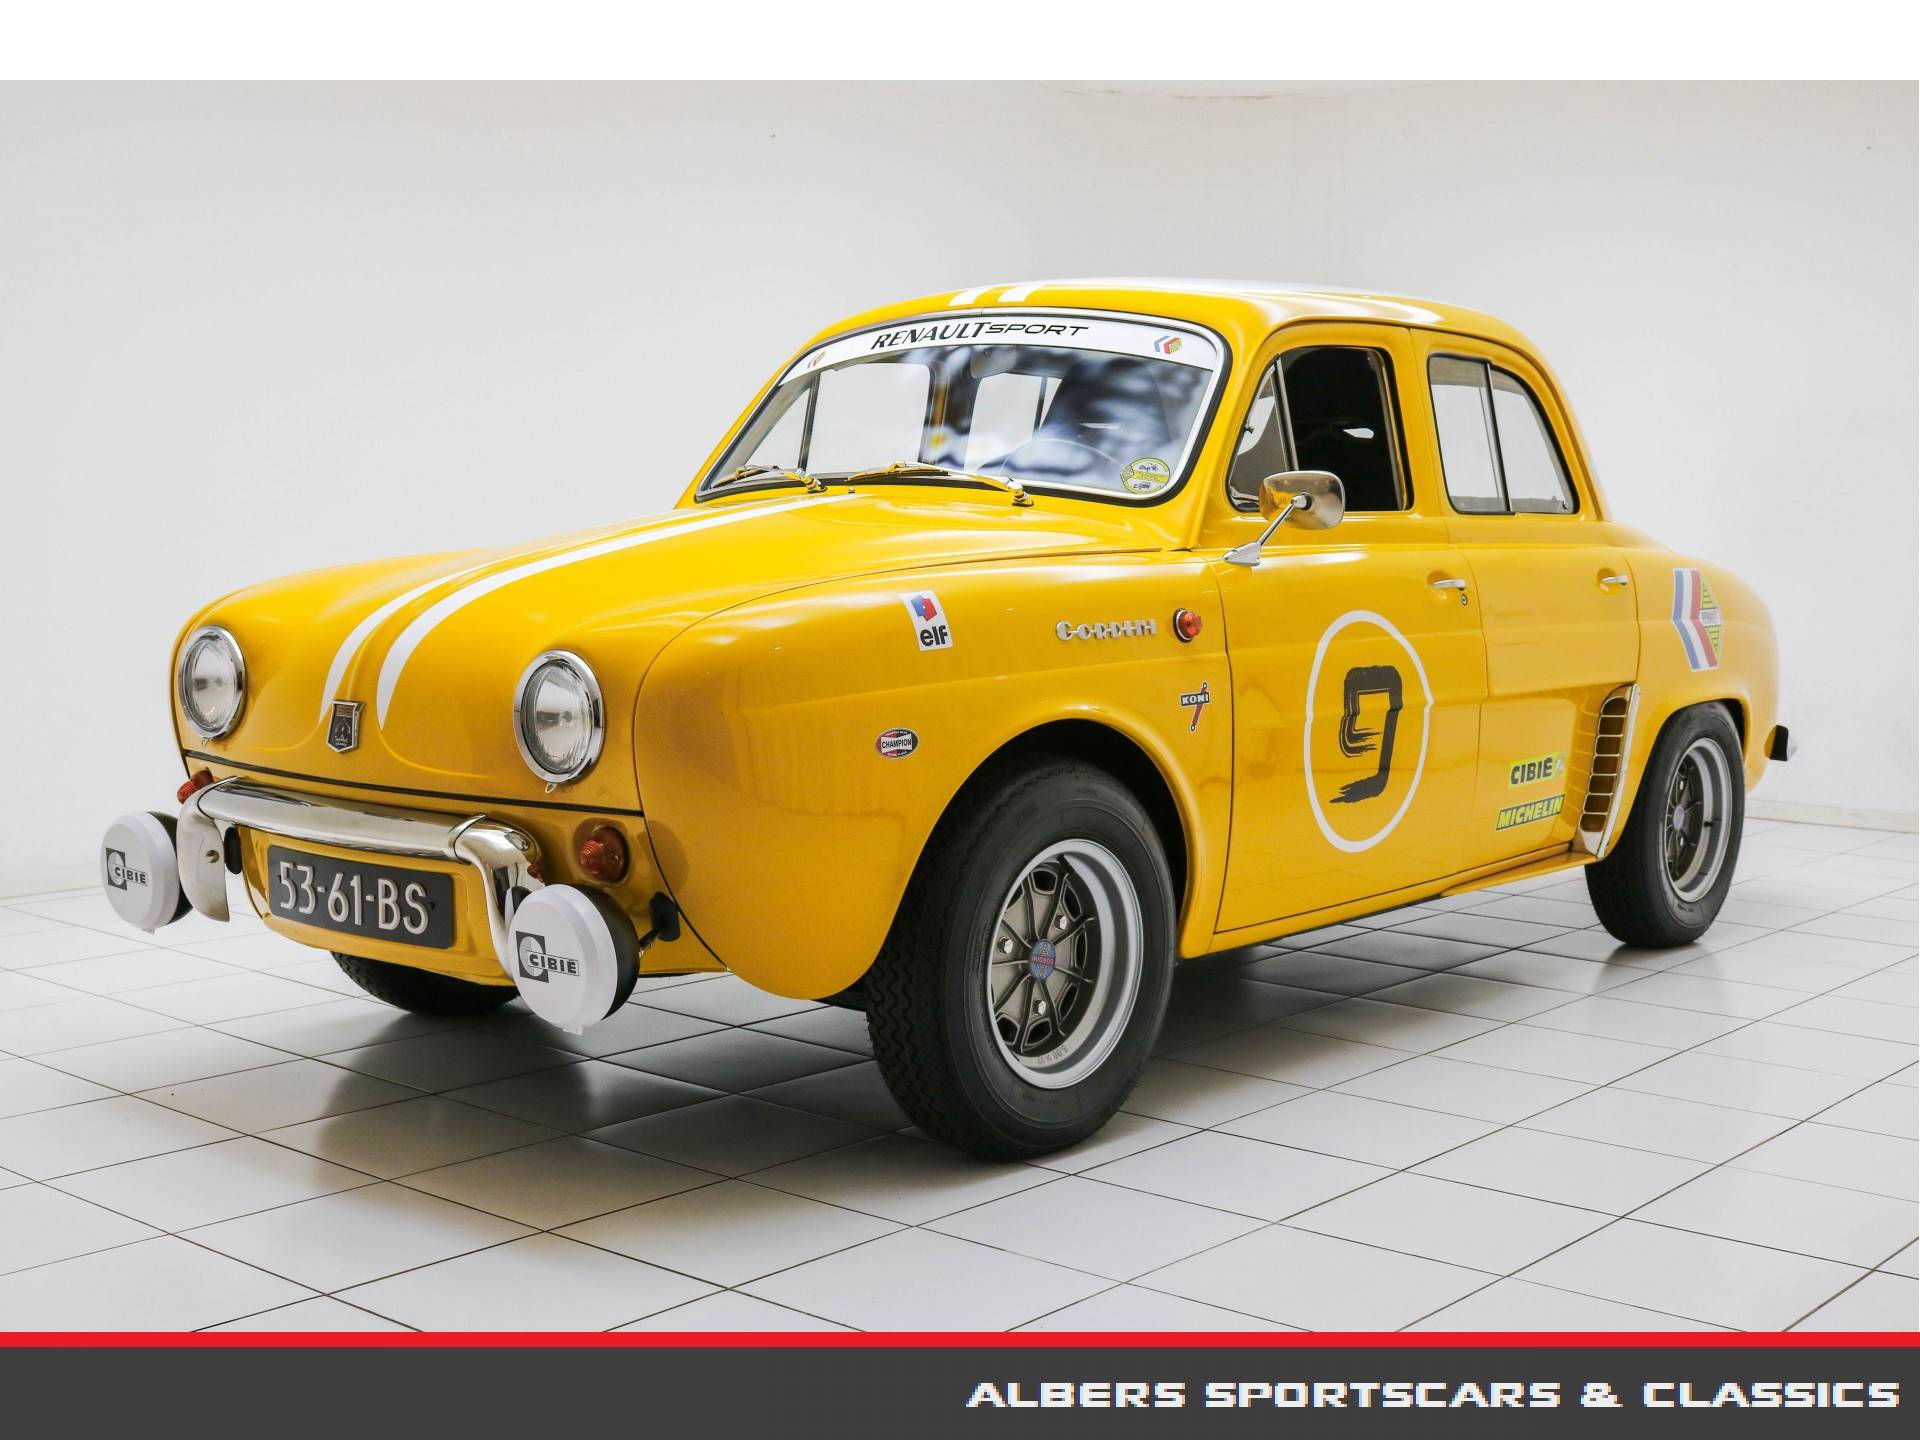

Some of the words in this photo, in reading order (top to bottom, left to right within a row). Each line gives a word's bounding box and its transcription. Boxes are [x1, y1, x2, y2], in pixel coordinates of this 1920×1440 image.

[920, 625, 948, 647] elf
[1182, 693, 1209, 705] KONI
[881, 738, 912, 749] CHAMPION
[1328, 665, 1404, 804] 9
[1497, 797, 1564, 829] MICHELIN
[279, 861, 429, 935] 53-61-BS
